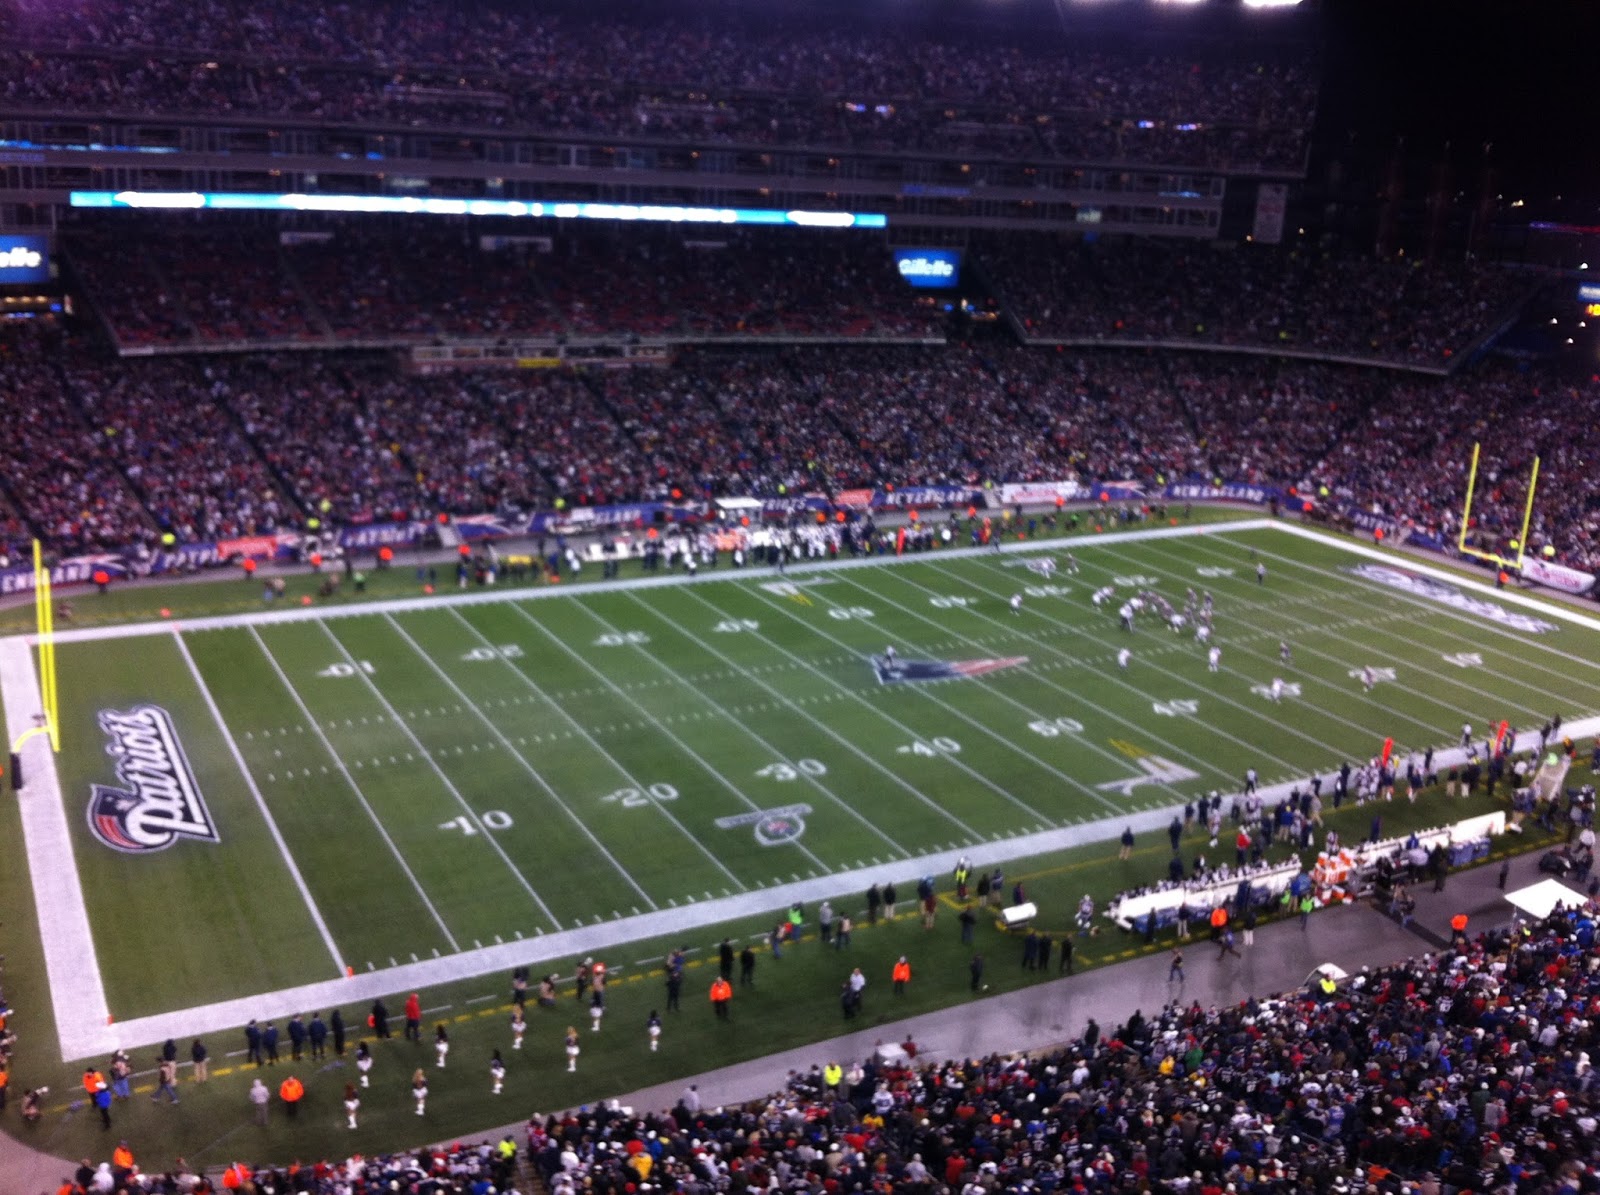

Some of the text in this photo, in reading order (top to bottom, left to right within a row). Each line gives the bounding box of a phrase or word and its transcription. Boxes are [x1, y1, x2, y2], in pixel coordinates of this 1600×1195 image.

[898, 258, 954, 277] Gillette
[912, 737, 961, 757] 40
[99, 704, 211, 842] Patriots
[771, 758, 827, 781] 30
[613, 783, 680, 808] 20
[452, 810, 514, 836] 10
